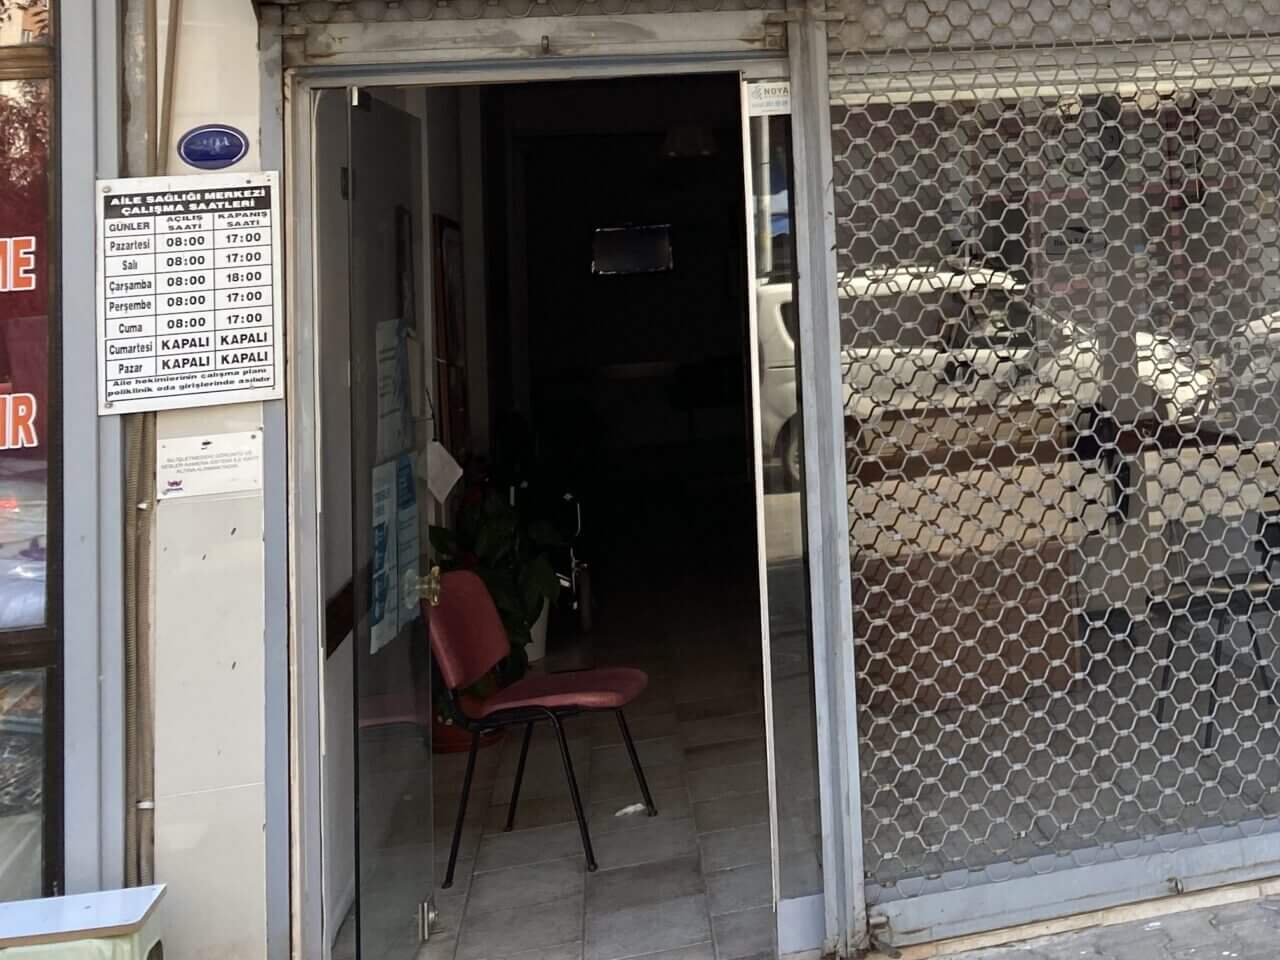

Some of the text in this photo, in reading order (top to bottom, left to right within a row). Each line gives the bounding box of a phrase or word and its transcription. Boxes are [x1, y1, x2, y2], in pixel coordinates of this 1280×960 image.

[110, 188, 266, 206] AİLE SAĞLIĞI MERKEZİ
[121, 200, 256, 216] ÇALIŞMA SAATLERİ
[110, 232, 262, 252] Pazartesi 08:00 17:00
[166, 255, 206, 267] 08:00
[226, 252, 262, 263] 17:00
[109, 271, 262, 294] Çarşamba 08:00 18:00
[109, 291, 263, 314] Perşembe 08:00 17:00
[118, 313, 263, 334] Cuma 08:00 17:00
[109, 332, 268, 356] Cumartesi KAPALI KAPALI
[118, 351, 268, 374] Pazar KAPALI KAPALI
